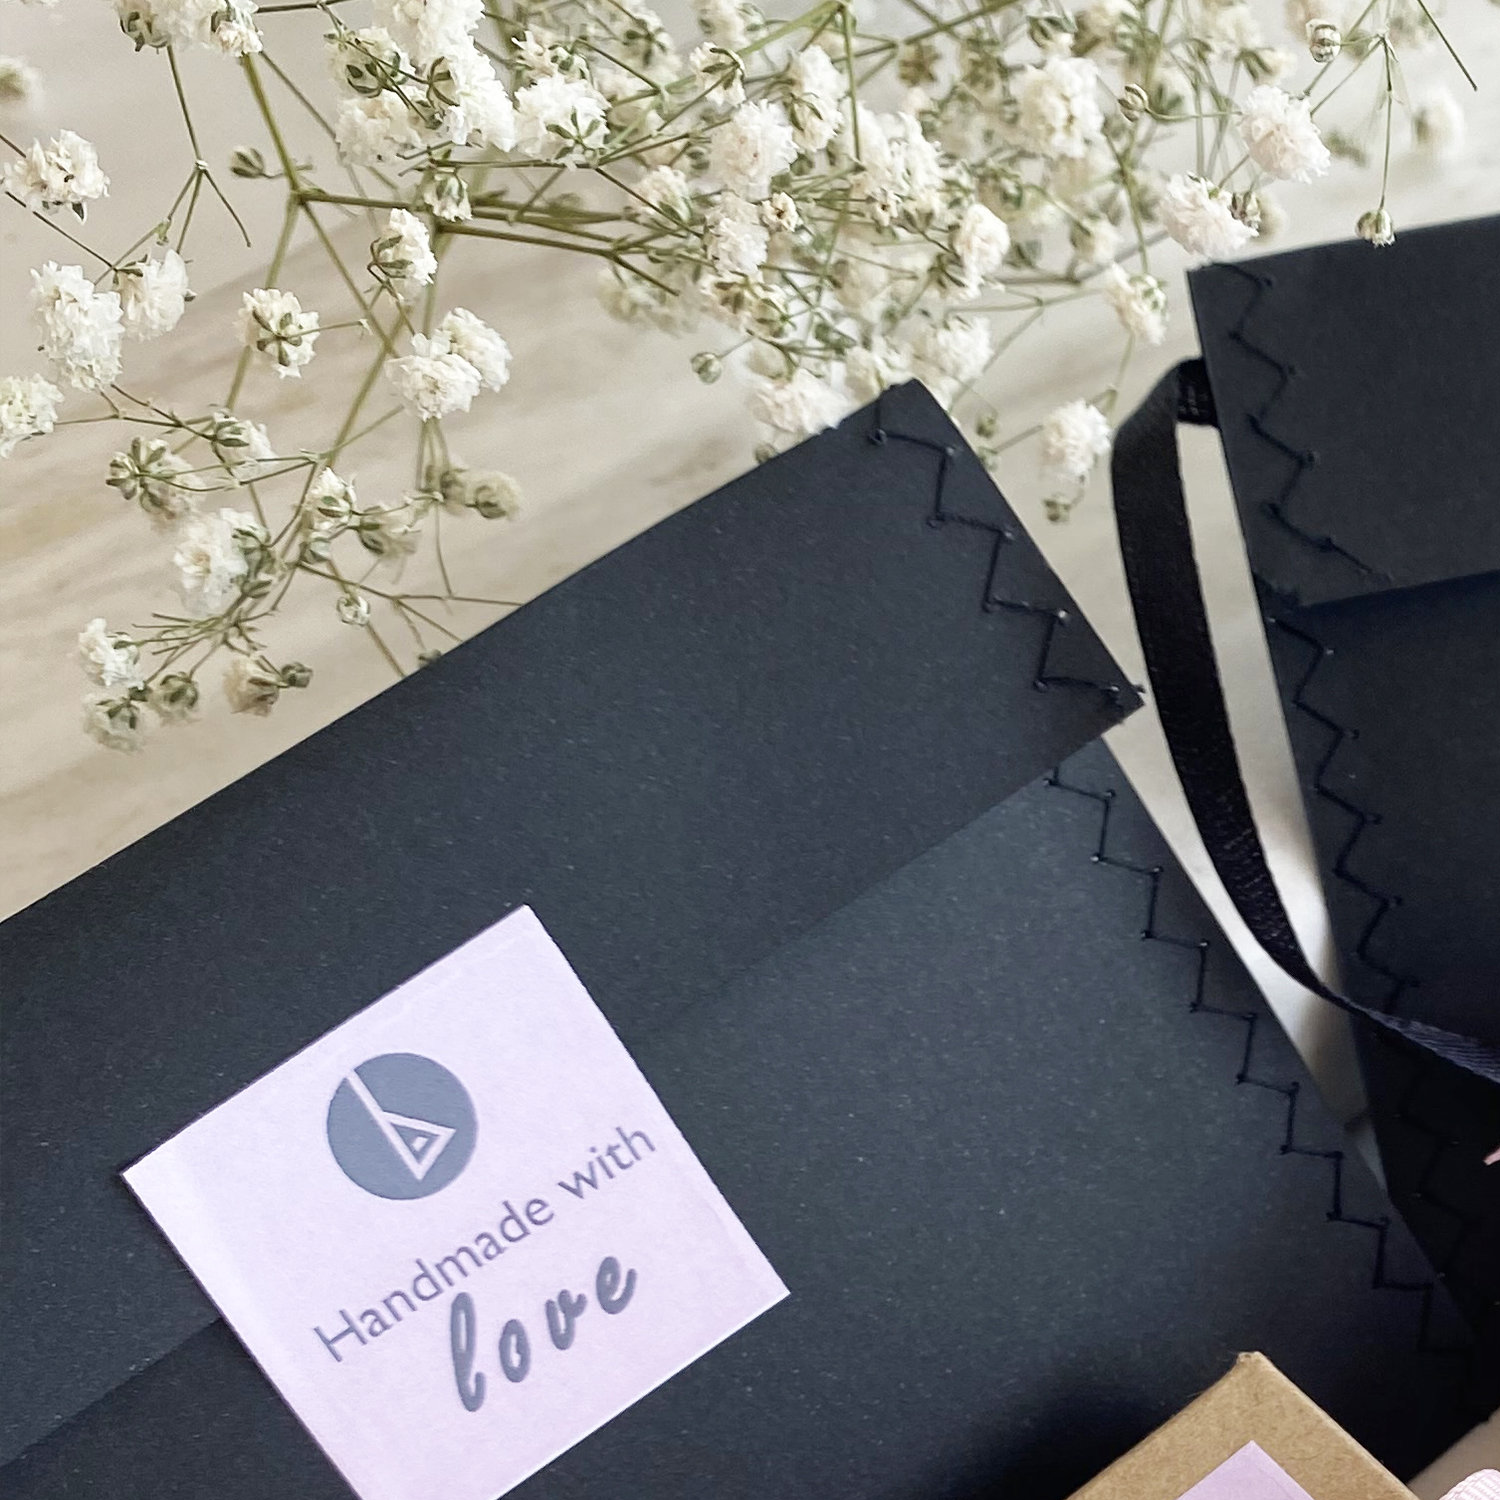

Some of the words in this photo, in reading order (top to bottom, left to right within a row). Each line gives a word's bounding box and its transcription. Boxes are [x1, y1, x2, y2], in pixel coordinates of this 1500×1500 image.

[312, 1197, 555, 1363] Handmade
[558, 1125, 656, 1200] with
[450, 1254, 638, 1412] love
